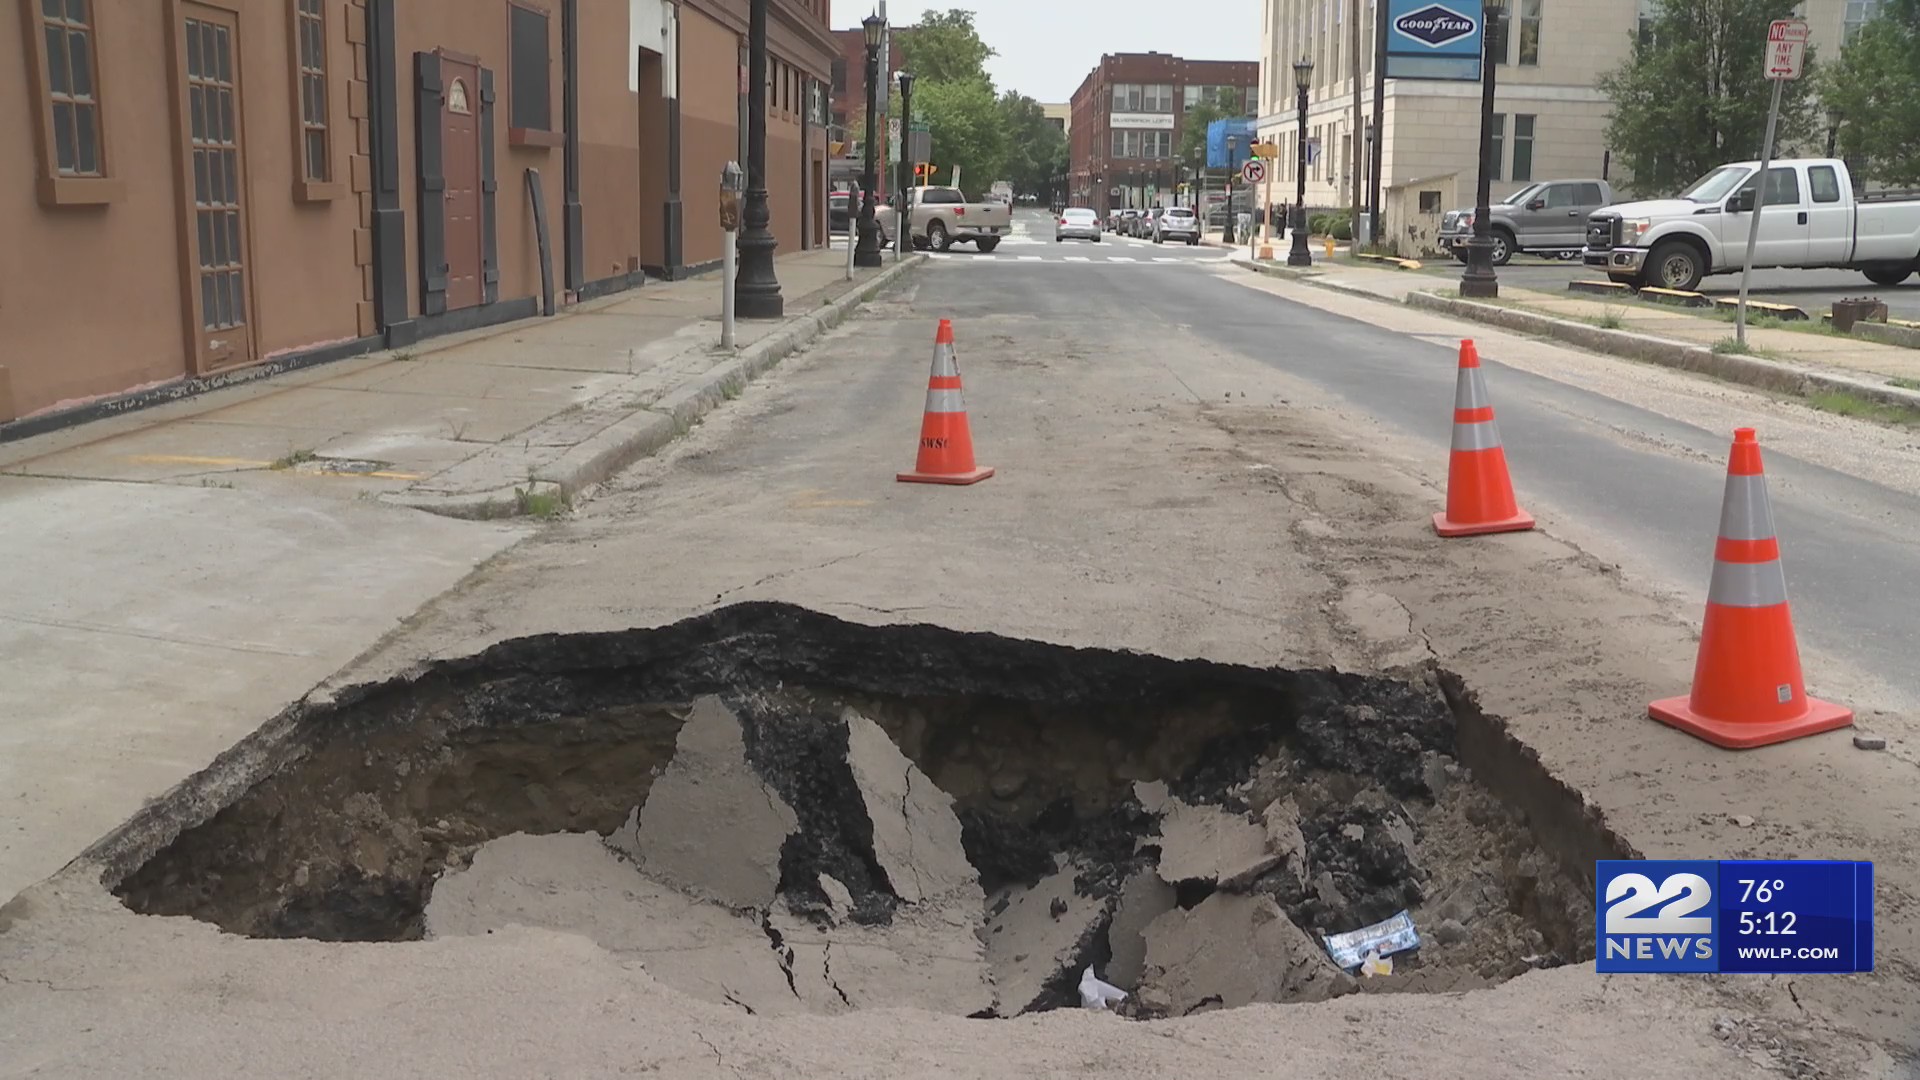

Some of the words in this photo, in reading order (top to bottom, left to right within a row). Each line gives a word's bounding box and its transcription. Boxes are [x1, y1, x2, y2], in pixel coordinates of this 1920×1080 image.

[1400, 18, 1471, 31] GOODYEAR
[1770, 23, 1786, 40] NO
[1776, 43, 1794, 53] ANY
[1775, 54, 1793, 66] TIME
